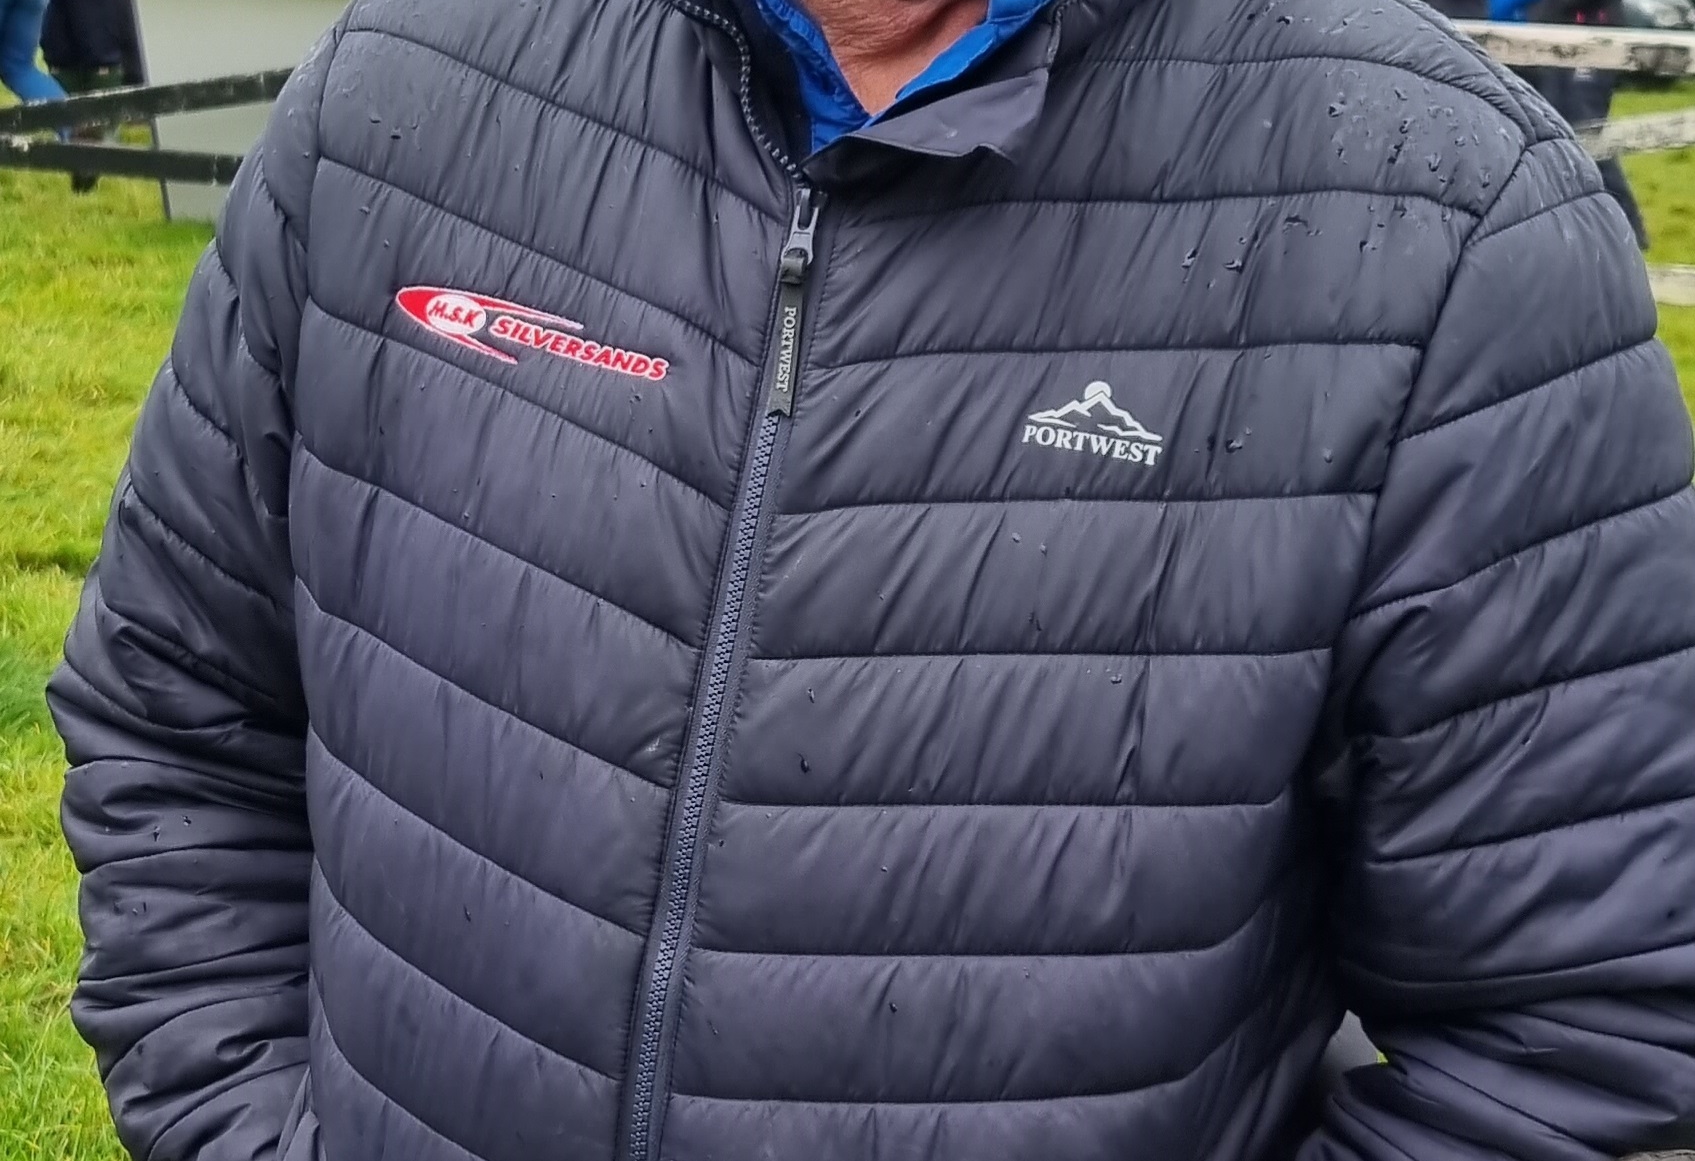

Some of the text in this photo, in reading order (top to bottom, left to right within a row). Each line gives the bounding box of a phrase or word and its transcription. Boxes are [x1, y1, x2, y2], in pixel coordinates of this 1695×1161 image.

[490, 317, 669, 379] SILVERSANDS
[775, 306, 797, 392] PORTWEST
[1021, 424, 1163, 466] PORTWEST
